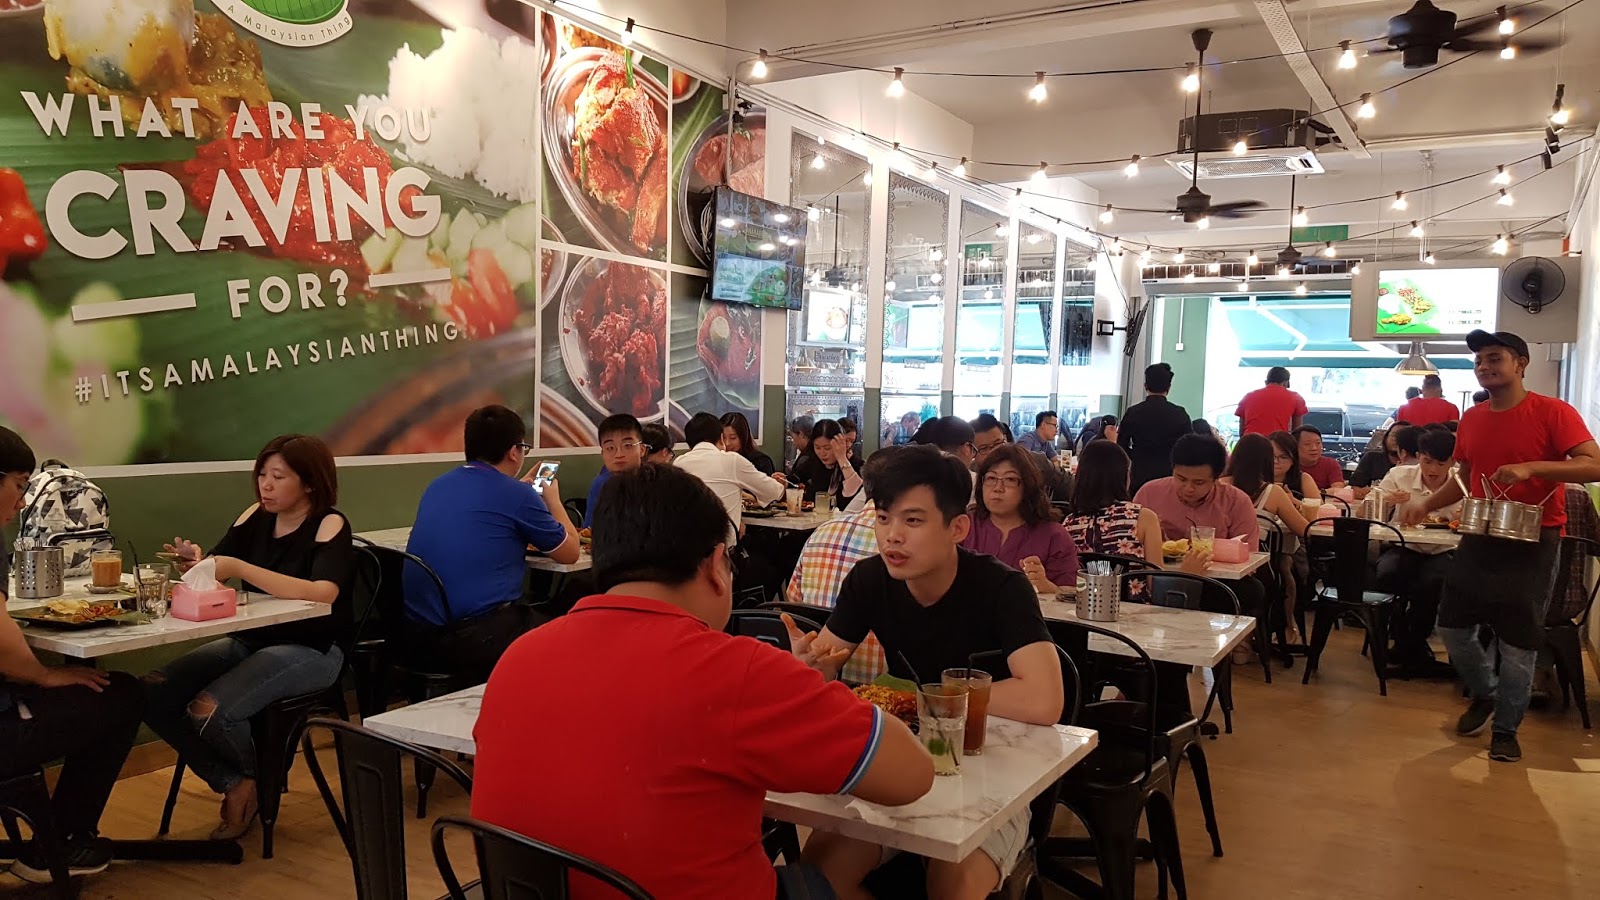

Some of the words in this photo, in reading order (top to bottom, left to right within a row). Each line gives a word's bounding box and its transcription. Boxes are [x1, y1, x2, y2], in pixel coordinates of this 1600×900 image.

[227, 5, 235, 14] A
[244, 15, 315, 41] Malaysian
[321, 16, 351, 39] Thing
[20, 91, 198, 138] WHAT
[232, 101, 325, 140] ARE
[345, 104, 432, 142] YOU
[45, 167, 442, 259] CRAVING
[227, 268, 349, 318] FOR?
[75, 320, 460, 403] #ITSAMALAYSIANTHING
